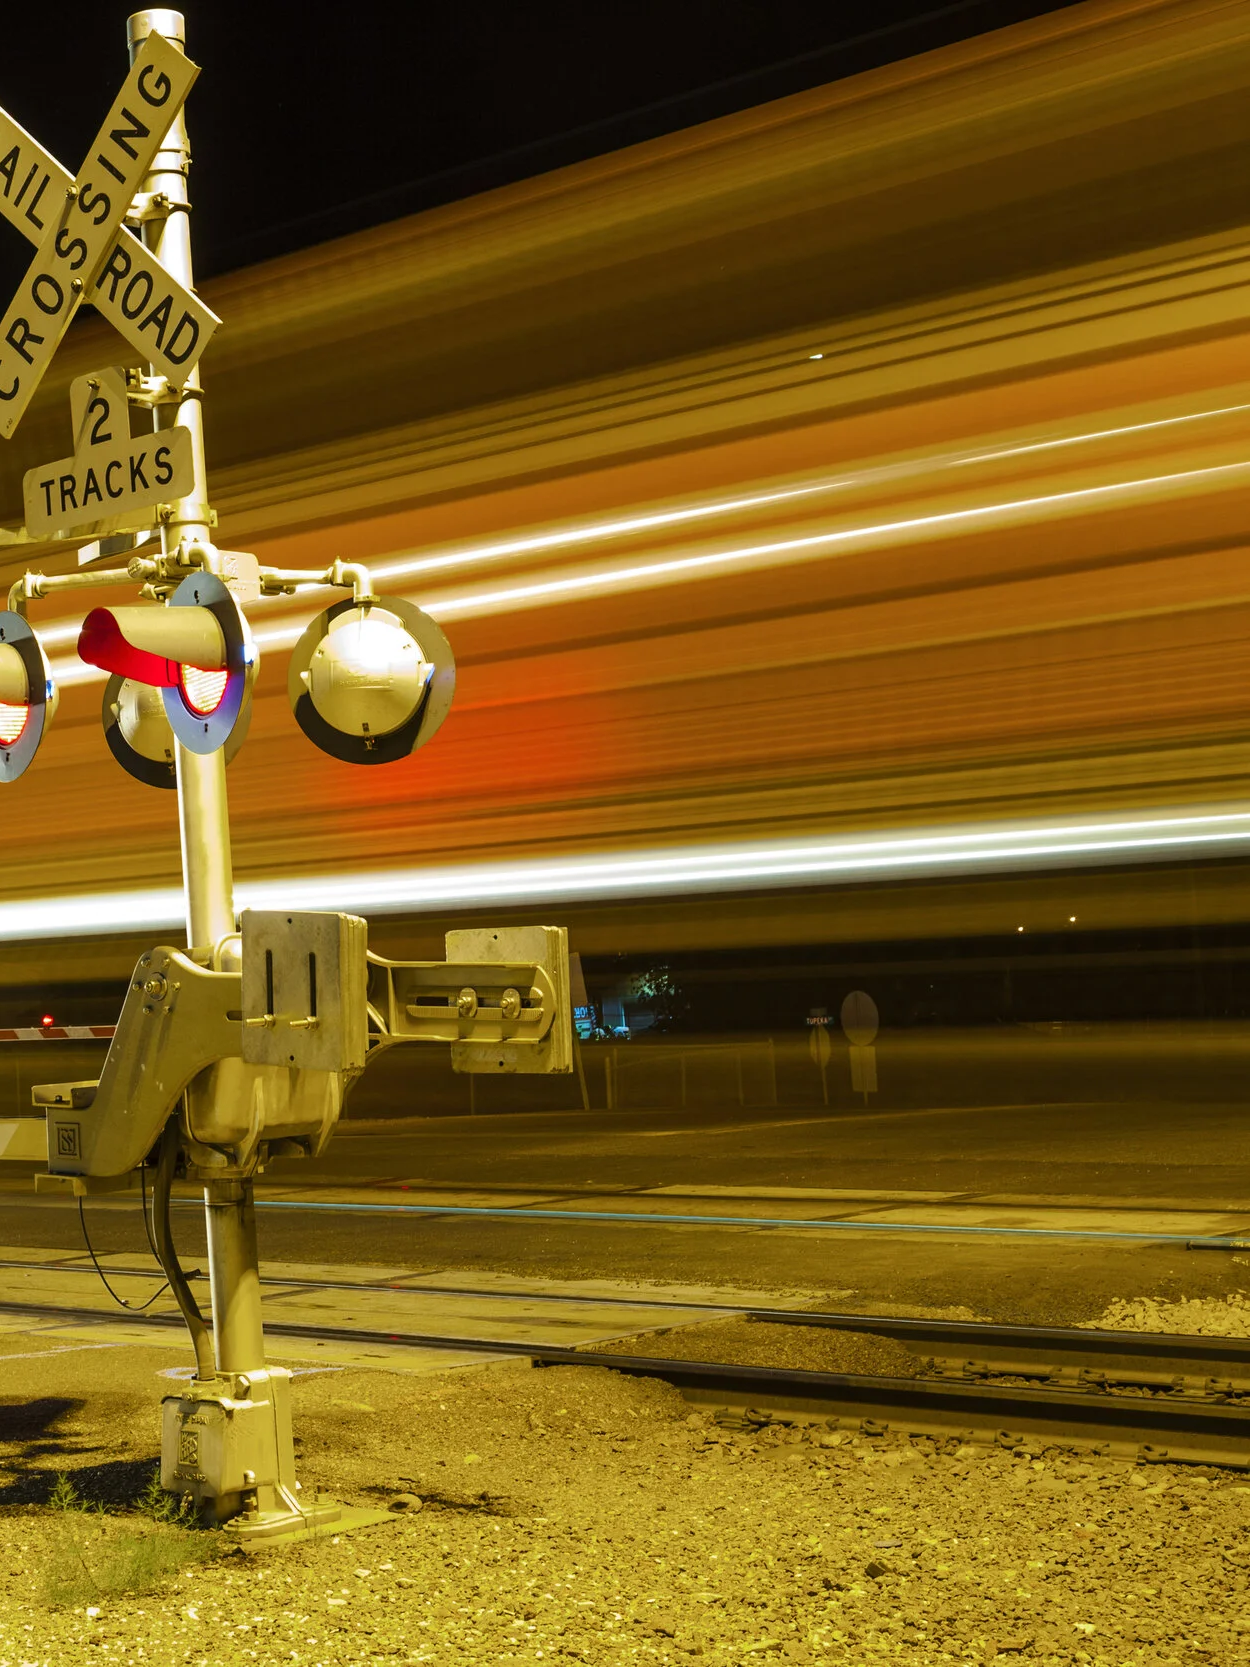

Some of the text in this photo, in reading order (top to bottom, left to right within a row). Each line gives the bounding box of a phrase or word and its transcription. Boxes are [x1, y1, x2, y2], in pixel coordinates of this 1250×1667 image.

[95, 243, 201, 366] ROAD
[87, 396, 113, 446] 2
[39, 445, 175, 518] TRACKS
